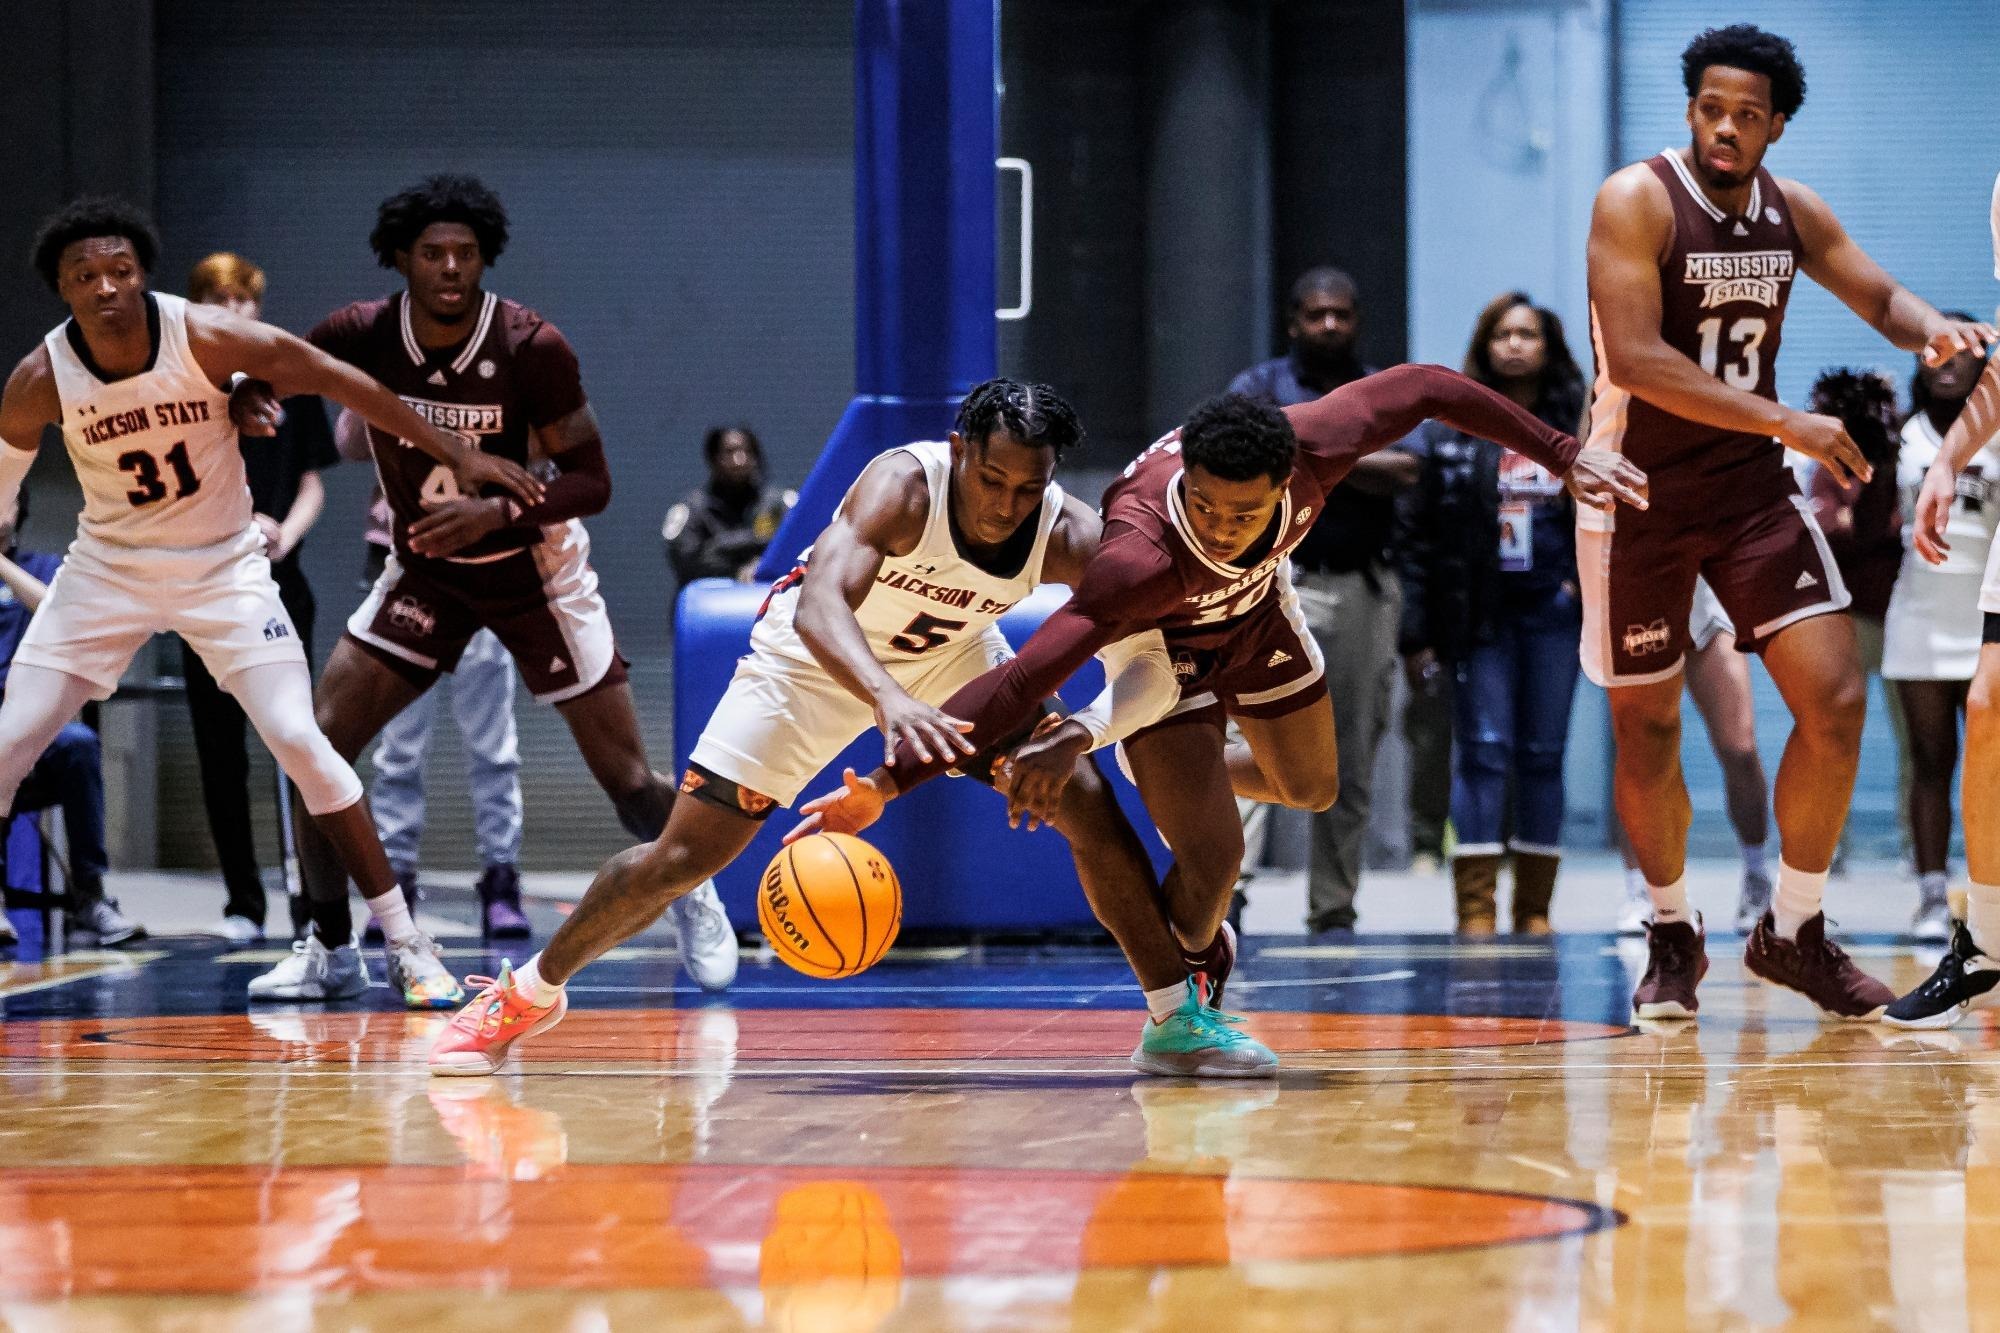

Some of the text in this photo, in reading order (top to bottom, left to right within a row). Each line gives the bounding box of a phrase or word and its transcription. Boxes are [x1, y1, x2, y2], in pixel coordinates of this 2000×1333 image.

[1684, 254, 1793, 279] MISSISSIPPI
[1717, 282, 1767, 301] STATE
[1696, 317, 1768, 391] 13
[83, 401, 209, 445] JACKSON STATE
[406, 402, 502, 430] SISSIPPI
[118, 440, 202, 507] 31
[419, 464, 460, 504] 4
[876, 570, 1020, 615] JACKSON STA
[1192, 571, 1274, 625] 10
[888, 610, 969, 655] 5
[766, 860, 810, 951] Wilson
